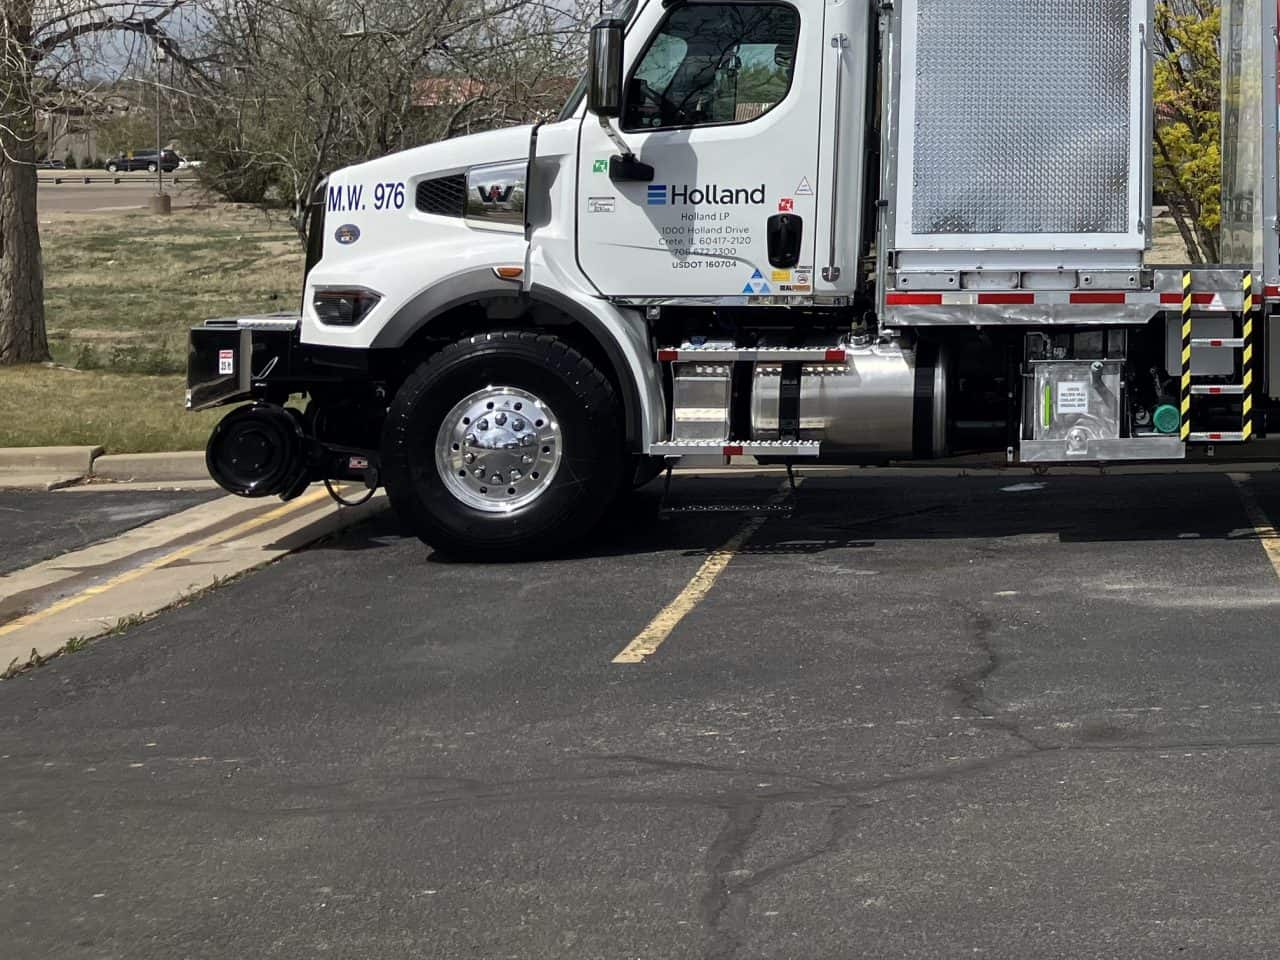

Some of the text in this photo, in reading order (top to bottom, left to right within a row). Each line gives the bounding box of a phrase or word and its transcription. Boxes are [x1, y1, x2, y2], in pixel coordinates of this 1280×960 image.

[374, 182, 405, 210] 976
[671, 184, 765, 205] Holland
[681, 212, 730, 221] Holland LP
[662, 226, 750, 235] 1000 Holland Drive
[699, 236, 752, 245] 60417-2120
[672, 260, 737, 269] USDOT 160704
